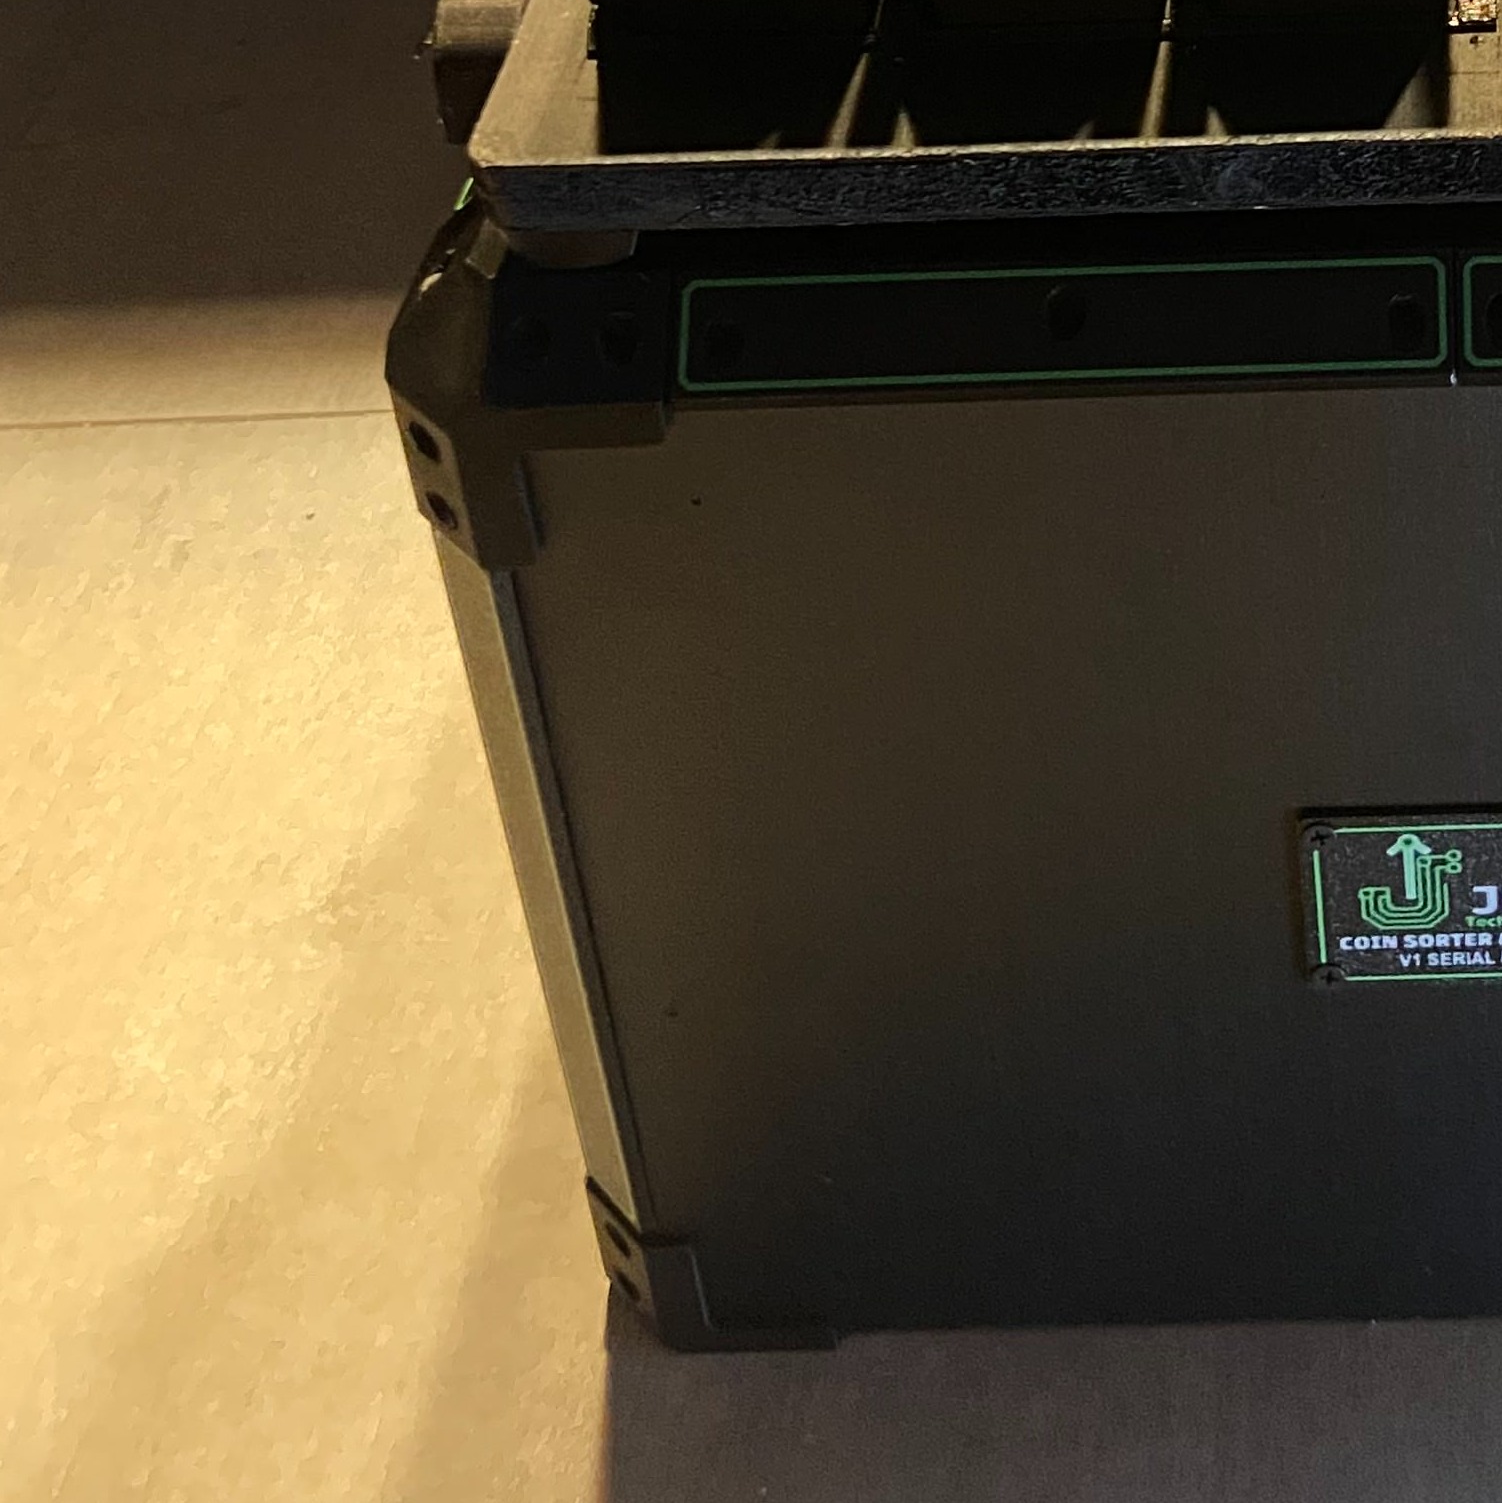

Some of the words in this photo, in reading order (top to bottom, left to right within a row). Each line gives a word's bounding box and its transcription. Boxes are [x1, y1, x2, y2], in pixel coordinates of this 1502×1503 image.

[1340, 934, 1398, 950] COIN
[1403, 932, 1493, 949] SORTER
[1399, 952, 1421, 966] V1
[1427, 951, 1495, 966] SERIAL
